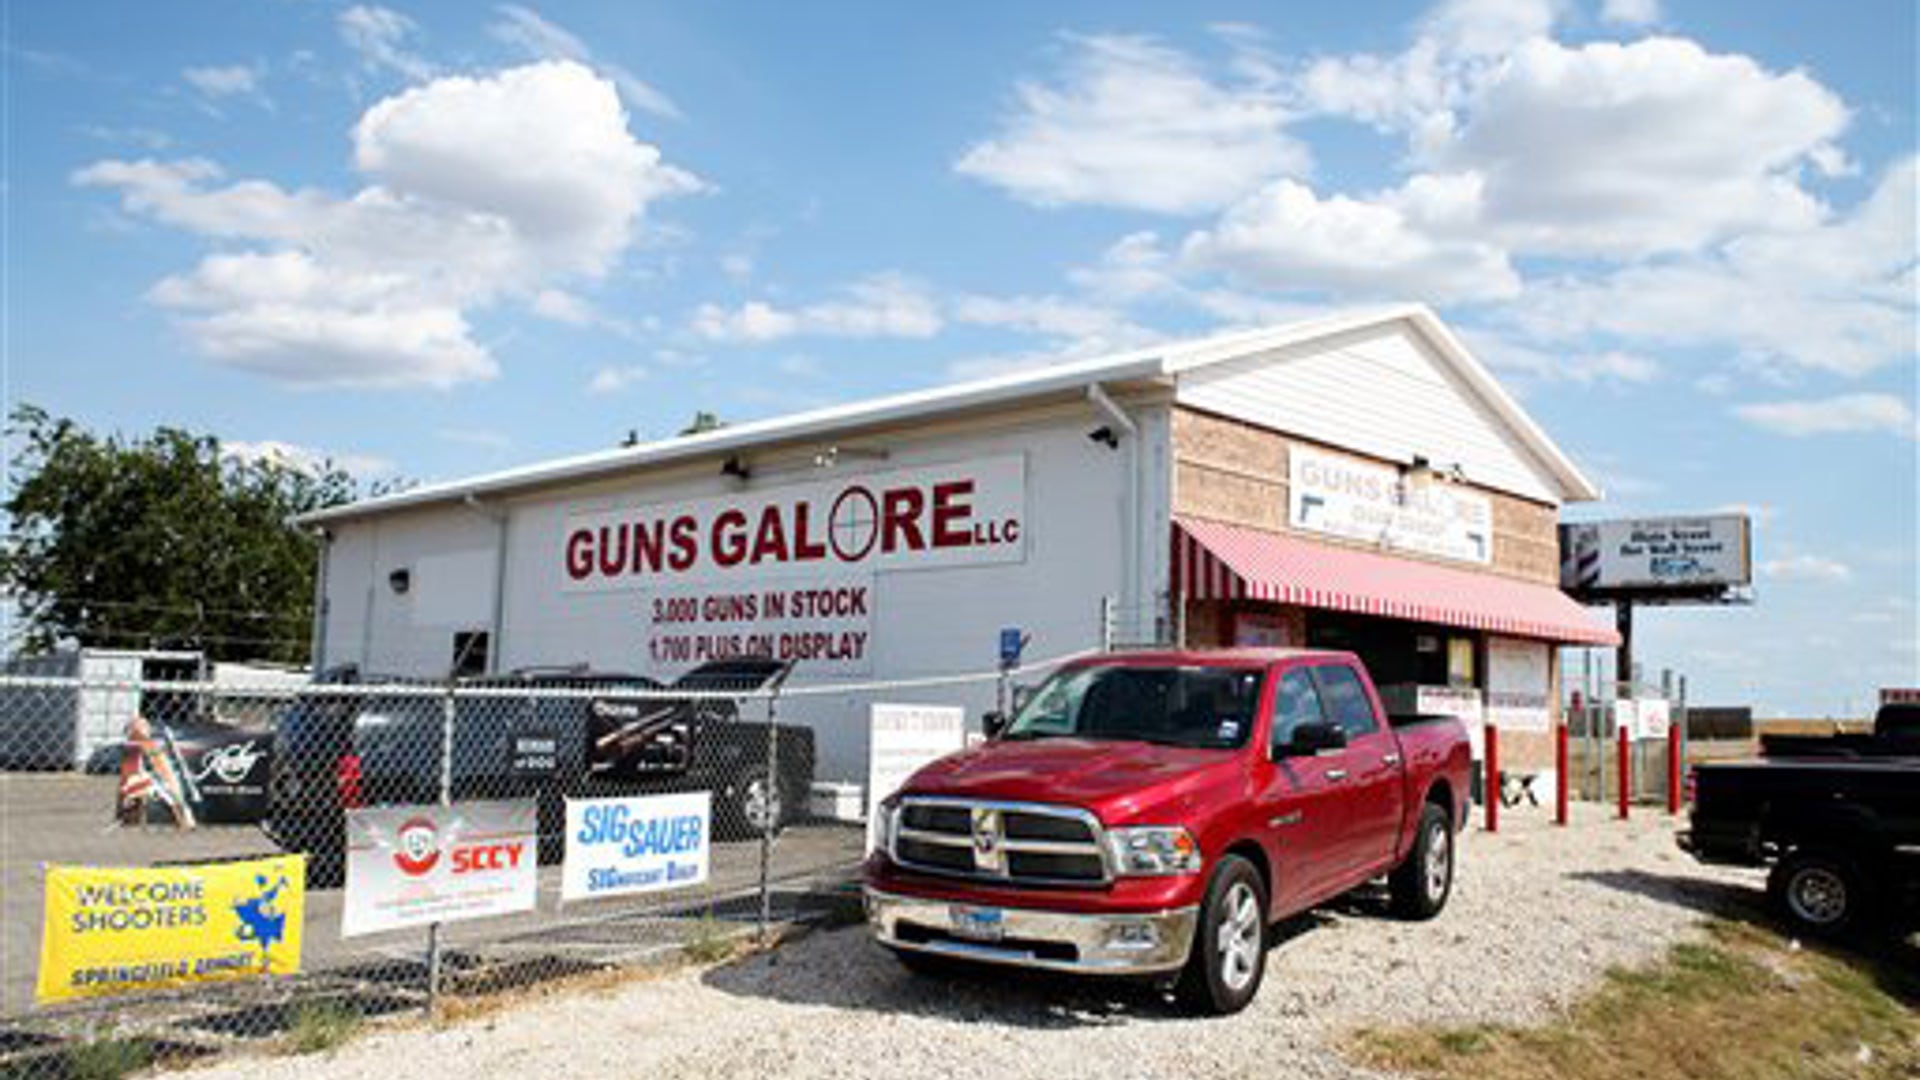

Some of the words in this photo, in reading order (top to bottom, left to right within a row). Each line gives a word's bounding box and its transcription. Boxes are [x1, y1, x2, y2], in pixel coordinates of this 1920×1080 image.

[1301, 459, 1381, 500] GUNS
[565, 514, 699, 580] GUNS
[711, 480, 975, 568] GALORE
[974, 518, 1021, 544] LLC
[702, 594, 758, 622] GUNS
[764, 591, 785, 619] IN
[790, 587, 867, 618] STOCK
[696, 634, 743, 660] PLUS
[746, 633, 774, 660] ON
[777, 631, 867, 660] DISPLAY
[577, 804, 631, 846] SIG
[623, 815, 702, 858] SAUER
[451, 842, 523, 874] SCCY
[75, 881, 205, 906] WELCOME
[71, 905, 208, 933] SHOOTERS
